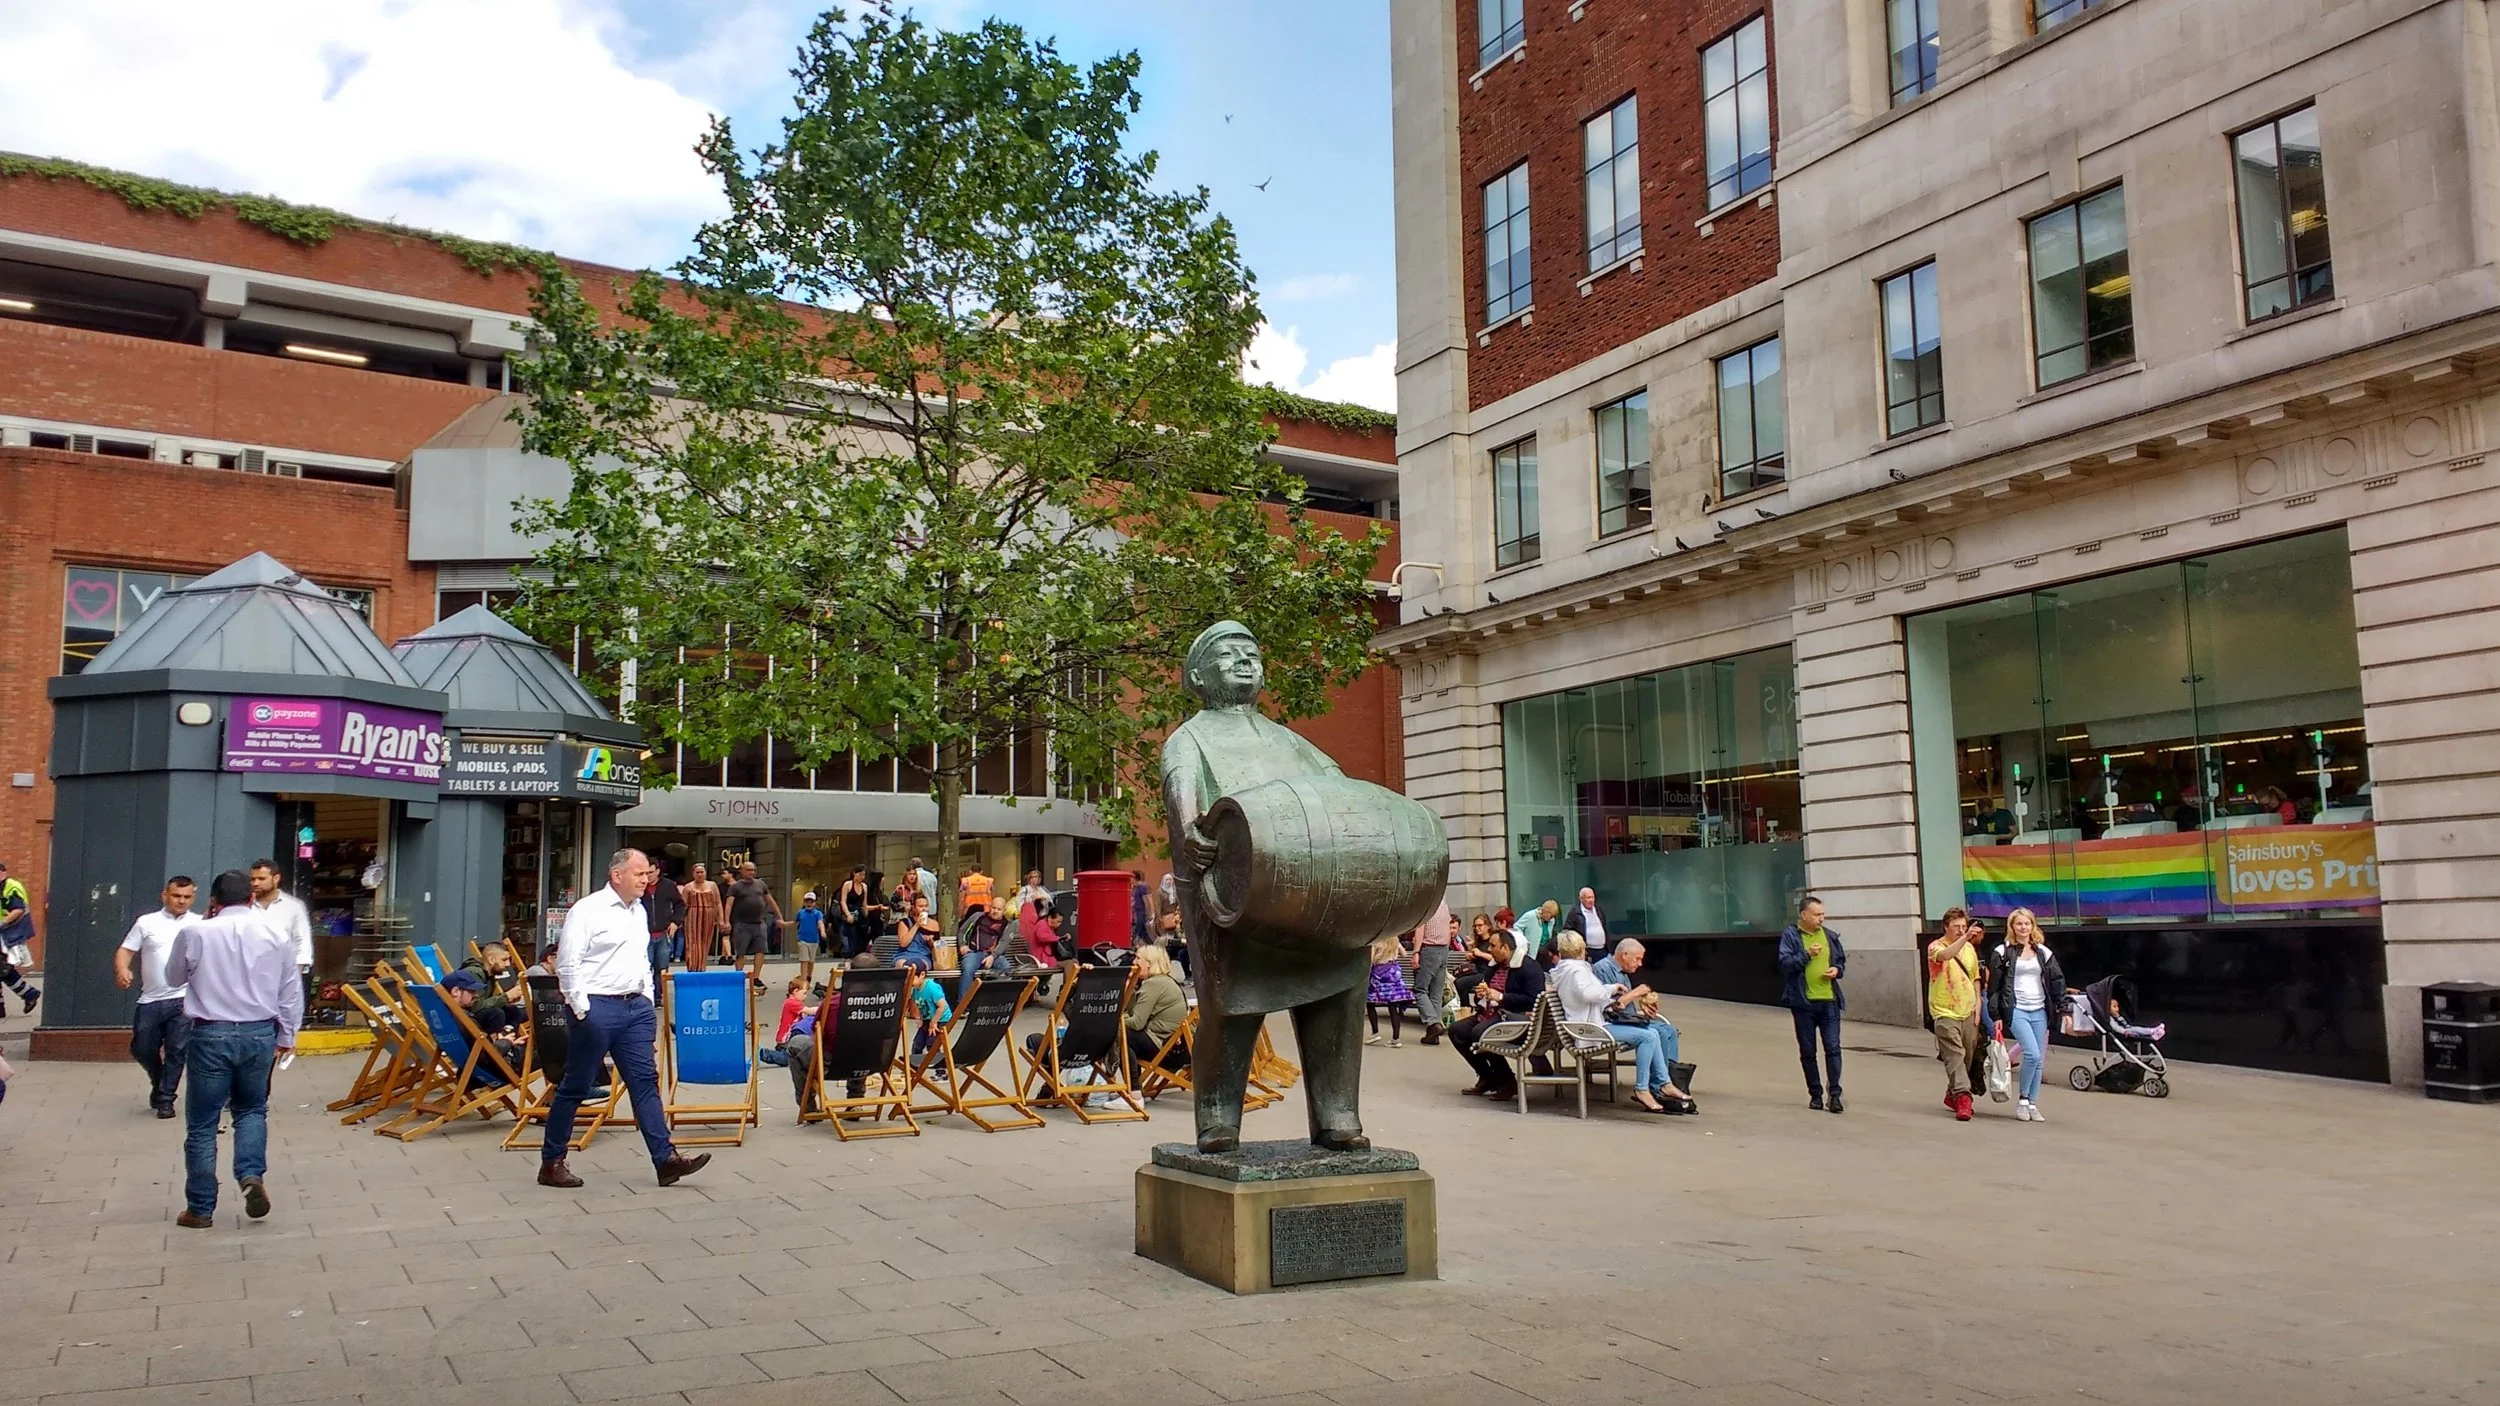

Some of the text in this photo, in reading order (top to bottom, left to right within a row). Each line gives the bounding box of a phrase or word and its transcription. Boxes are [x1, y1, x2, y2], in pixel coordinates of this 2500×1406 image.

[273, 709, 318, 720] payzone
[272, 732, 293, 740] Phone
[340, 711, 442, 765] Ryan's
[461, 743, 546, 755] WE BUY & SELL
[414, 765, 442, 779] KIOSK
[456, 761, 510, 775] MOBILES,
[447, 779, 560, 792] TABLETS & LAPTOPS
[1663, 790, 1709, 804] Tobacc
[727, 800, 780, 817] JOHNS
[2228, 840, 2325, 863] Sainsbury's
[2229, 855, 2380, 894] loves Pri
